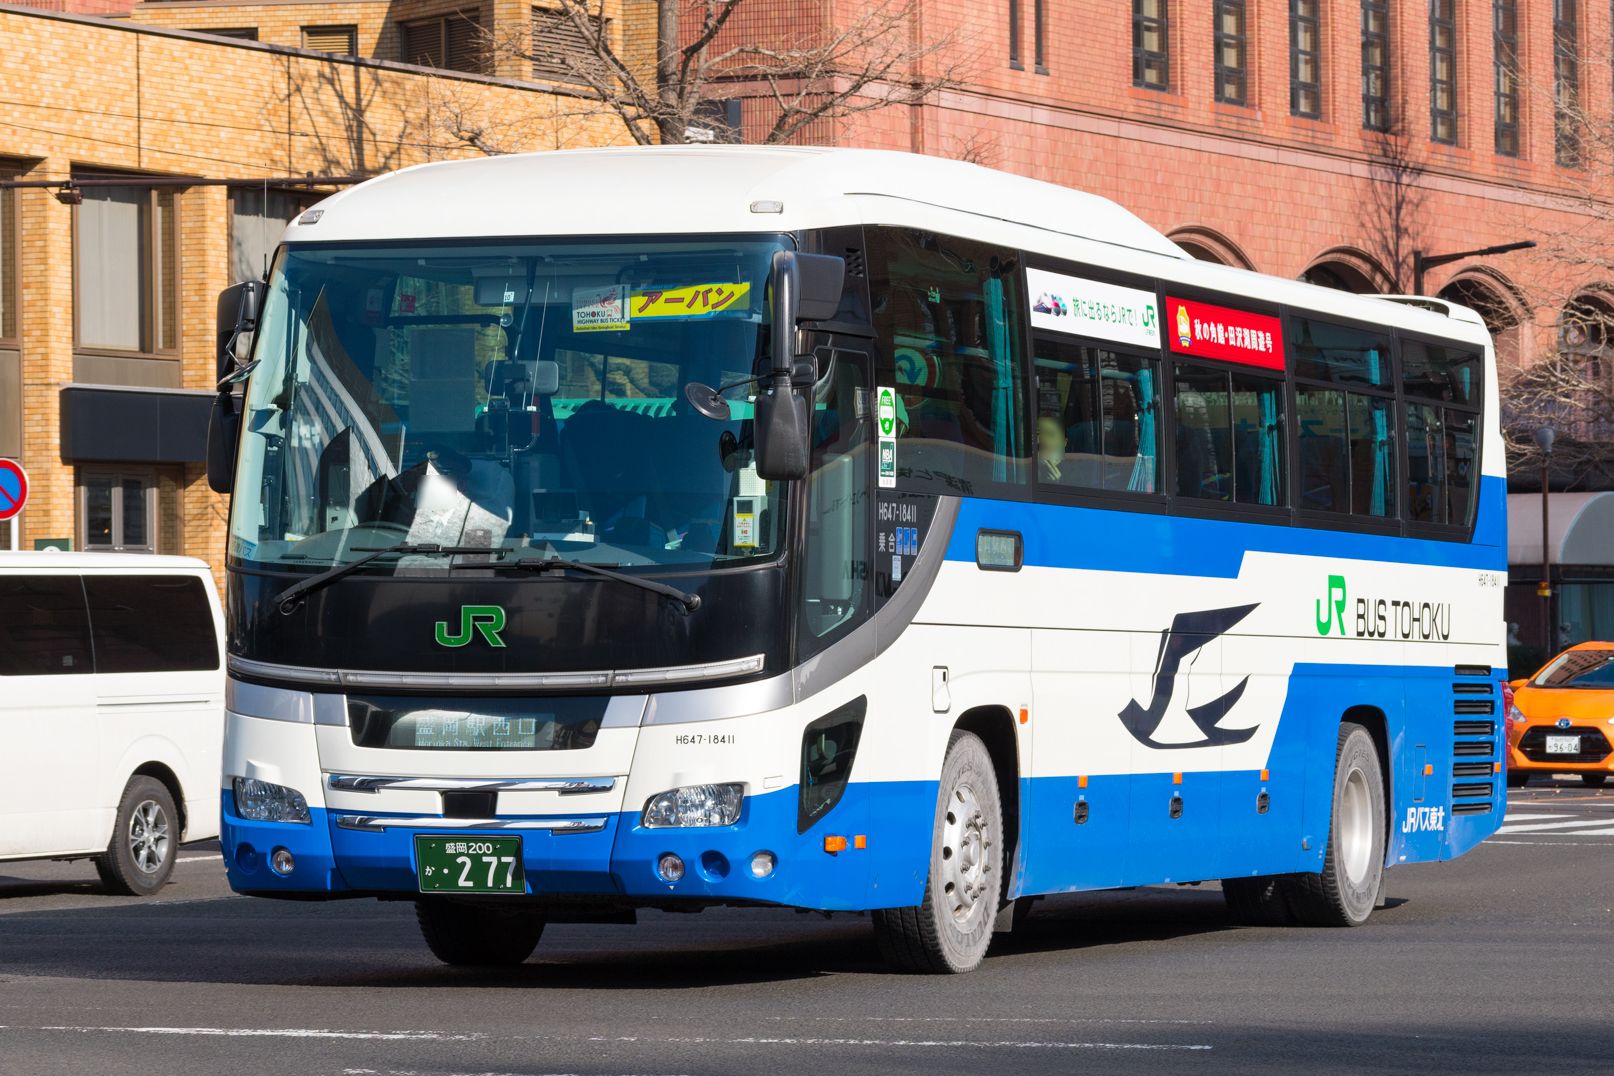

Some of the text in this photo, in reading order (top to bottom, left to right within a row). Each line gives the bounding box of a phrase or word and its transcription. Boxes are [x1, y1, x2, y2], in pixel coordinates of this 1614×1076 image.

[638, 288, 735, 313] アーバン
[577, 310, 606, 319] TOHOKU
[1142, 304, 1156, 329] JR
[878, 501, 917, 524] H647-18411
[1316, 574, 1347, 636] JR
[435, 605, 507, 648] JR
[1356, 598, 1451, 641] BUS TOHOKU
[675, 734, 735, 744] H647-18411
[1402, 805, 1446, 833] JRバス東北
[424, 865, 435, 876] か
